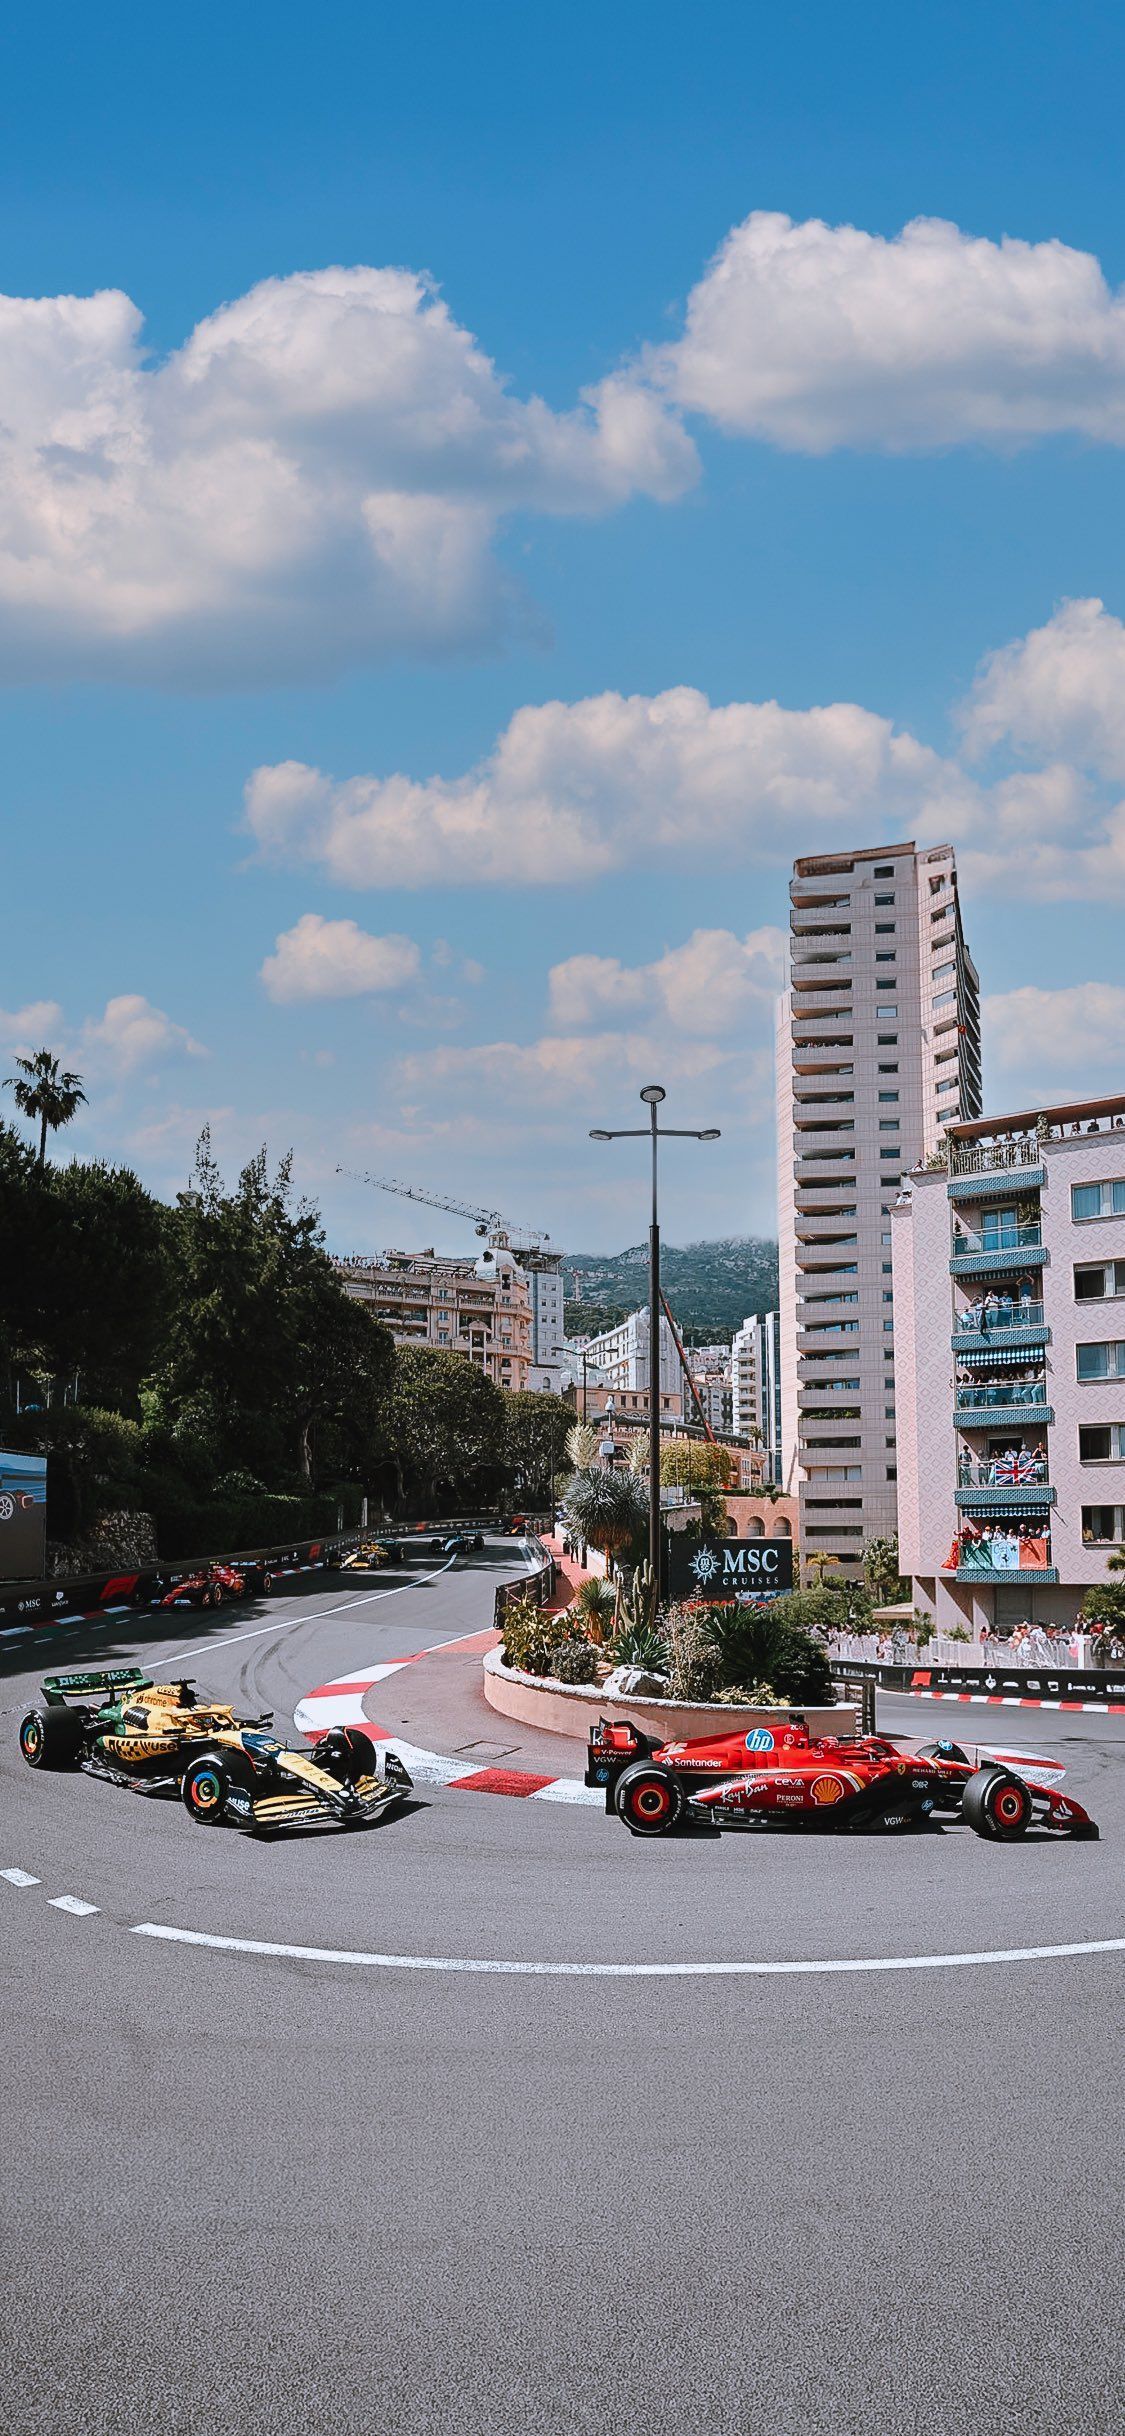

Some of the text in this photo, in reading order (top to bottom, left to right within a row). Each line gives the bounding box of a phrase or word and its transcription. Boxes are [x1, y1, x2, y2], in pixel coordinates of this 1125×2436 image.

[722, 1548, 779, 1573] MSC
[722, 1577, 779, 1586] CRUISES
[25, 1598, 41, 1608] MSC
[143, 1695, 167, 1708] chrome
[749, 1729, 771, 1751] hp
[674, 1757, 722, 1768] Santander
[720, 1776, 769, 1804] Ray-Ban
[776, 1794, 804, 1802] PERONI
[882, 1816, 904, 1827] VGW
